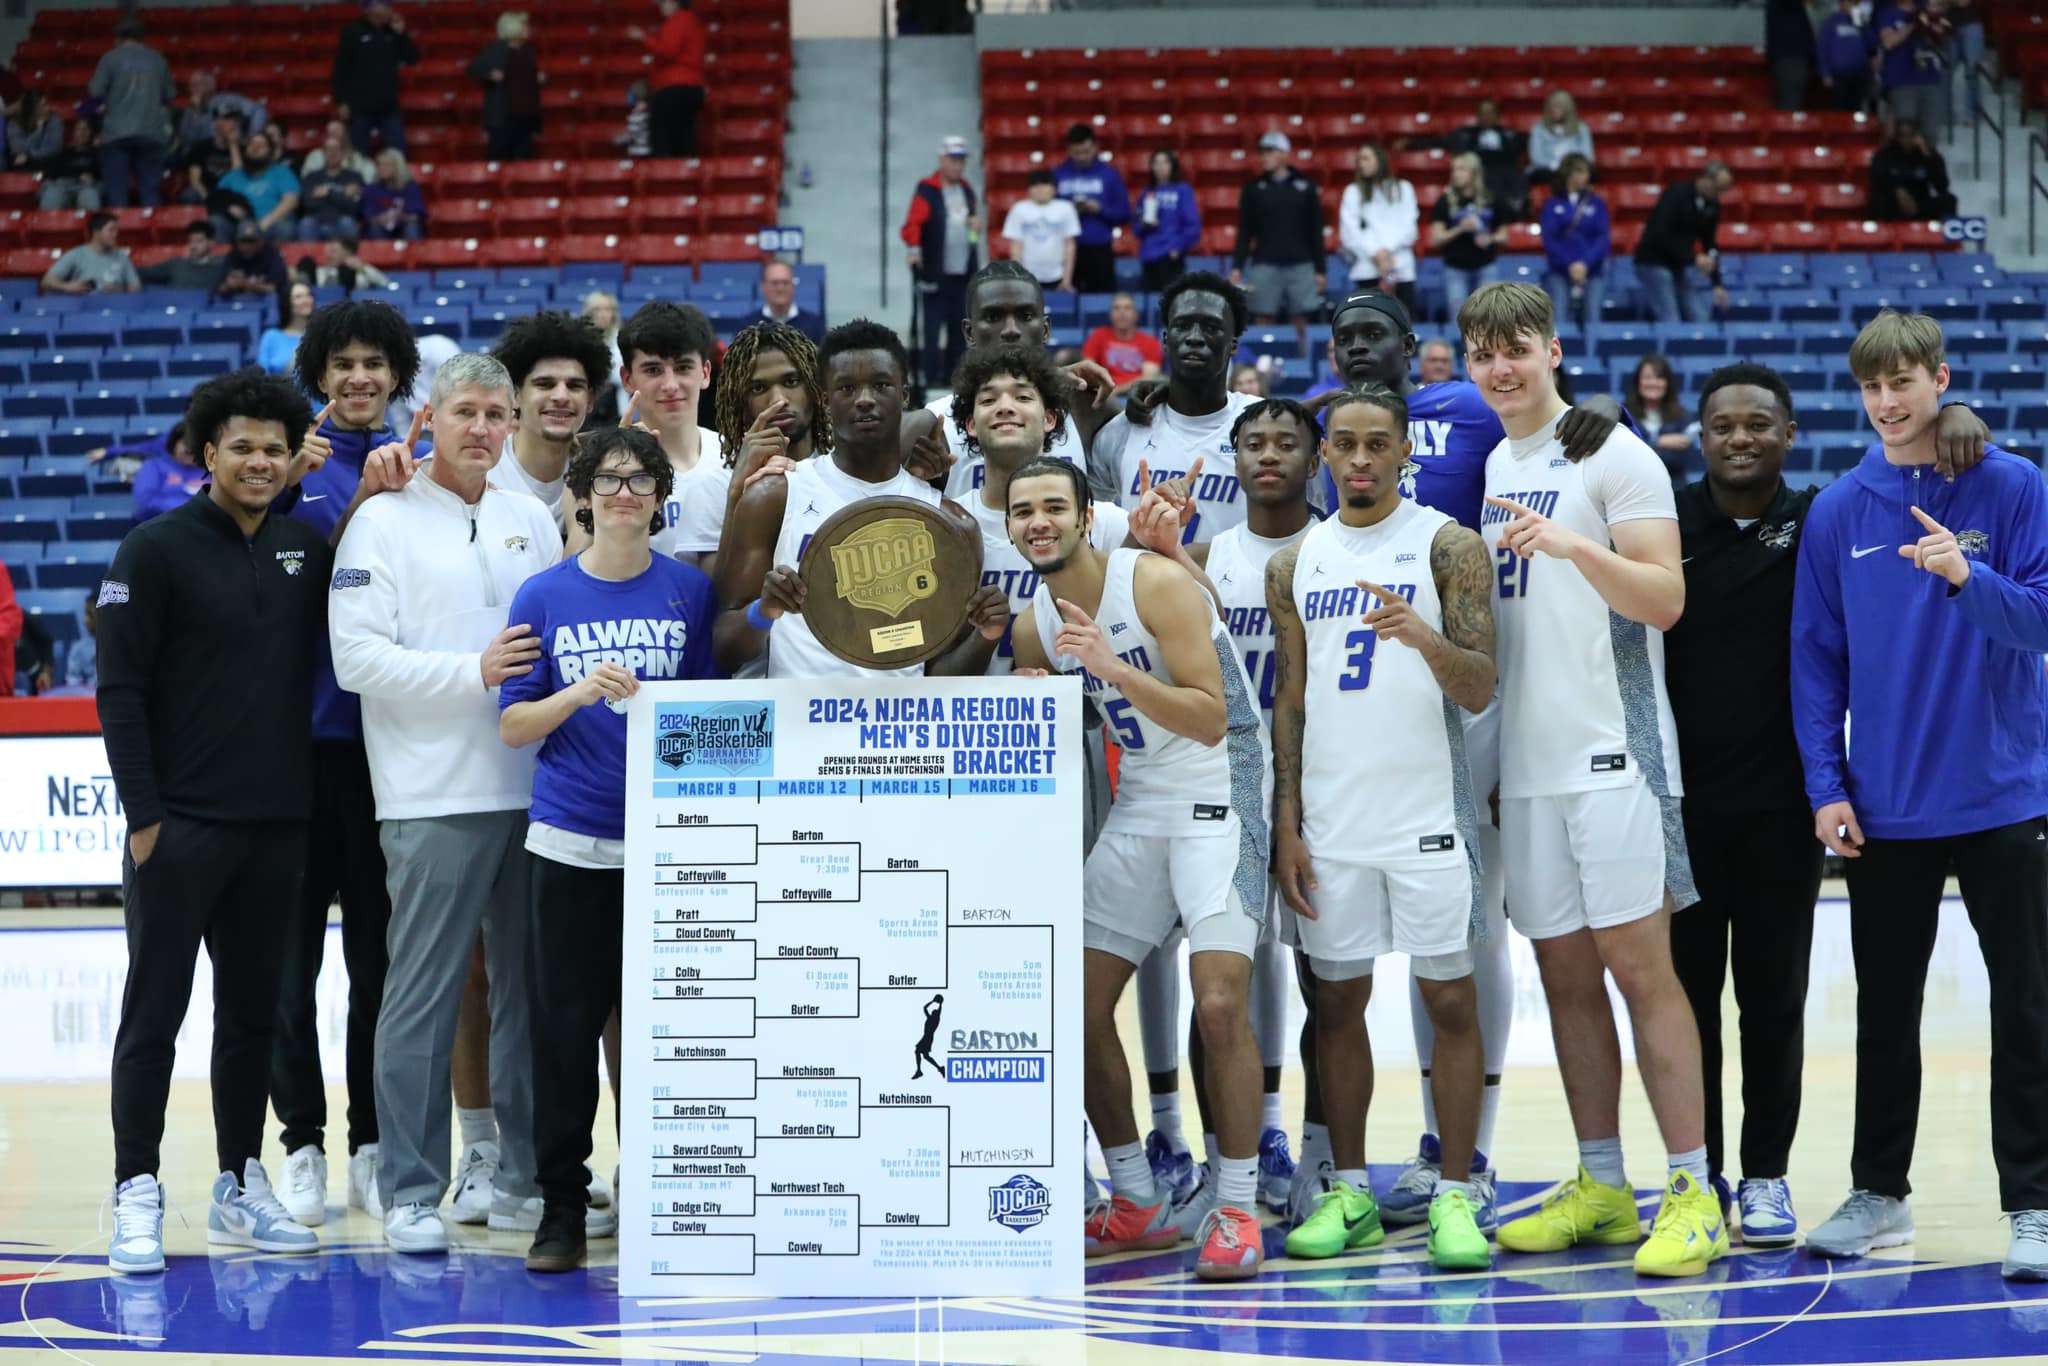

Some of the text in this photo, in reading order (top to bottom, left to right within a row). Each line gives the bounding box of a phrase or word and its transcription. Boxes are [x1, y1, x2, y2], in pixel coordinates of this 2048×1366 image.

[836, 533, 931, 596] NJCAA
[1497, 548, 1529, 598] 21
[915, 576, 928, 590] 6
[553, 619, 687, 656] ALWAYS
[1339, 630, 1377, 691] 3
[809, 698, 1056, 723] 2024 NJCAA REGION 6
[660, 714, 690, 729] 2024
[692, 715, 739, 734] Region
[1104, 698, 1146, 749] 5
[698, 731, 772, 748] Basketball
[860, 724, 1056, 749] MEN'S DIVISION I
[658, 738, 695, 755] NJCAA
[698, 749, 760, 758] TOURNAMENT
[824, 756, 945, 765] OPENING ROUNDS AT HOME SITES
[953, 751, 1056, 774] BRACKET
[818, 767, 842, 775] SEMIS
[852, 766, 881, 775] FINALS
[883, 766, 892, 774] IN
[894, 765, 945, 774] HUTCHINSON
[678, 783, 736, 795] MARCH 9
[778, 782, 847, 794] MARCH 12
[872, 781, 941, 793] MARCH 15
[969, 780, 1038, 793] MARCH 16
[678, 814, 708, 824] Barton
[792, 830, 823, 840] Barton
[887, 858, 919, 869] Barton
[677, 870, 726, 883] Coffeyville
[782, 889, 832, 901] Coffeyville
[676, 909, 699, 920] Pratt
[963, 909, 1011, 921] BARTON
[676, 928, 701, 939] Cloud
[703, 928, 735, 940] County
[778, 946, 838, 959] Cloud County
[675, 967, 700, 979] Colby
[888, 975, 917, 986] Butler
[675, 986, 703, 996] Butler
[791, 1004, 819, 1015] Butler
[951, 1030, 1038, 1050] BARTON
[674, 1046, 726, 1057] Hutchinson
[783, 1065, 835, 1077] Hutchinson
[952, 1060, 1040, 1079] CHAMPION
[879, 1094, 931, 1105] Hutchinson
[674, 1105, 705, 1116] Garden
[708, 1105, 726, 1117] City
[782, 1124, 834, 1137] Garden City
[673, 1145, 708, 1156] Seward
[710, 1145, 743, 1157] County
[961, 1148, 1034, 1163] HUTCHINSON
[673, 1164, 721, 1174] Northwest
[725, 1163, 746, 1174] Tech
[771, 1182, 844, 1193] Northwest Tech
[673, 1203, 701, 1215] Dodge
[704, 1202, 721, 1214] City
[992, 1189, 1046, 1216] NJCAA
[886, 1213, 919, 1225] Cowley
[673, 1221, 706, 1234] Cowley
[788, 1242, 822, 1254] Cowley
